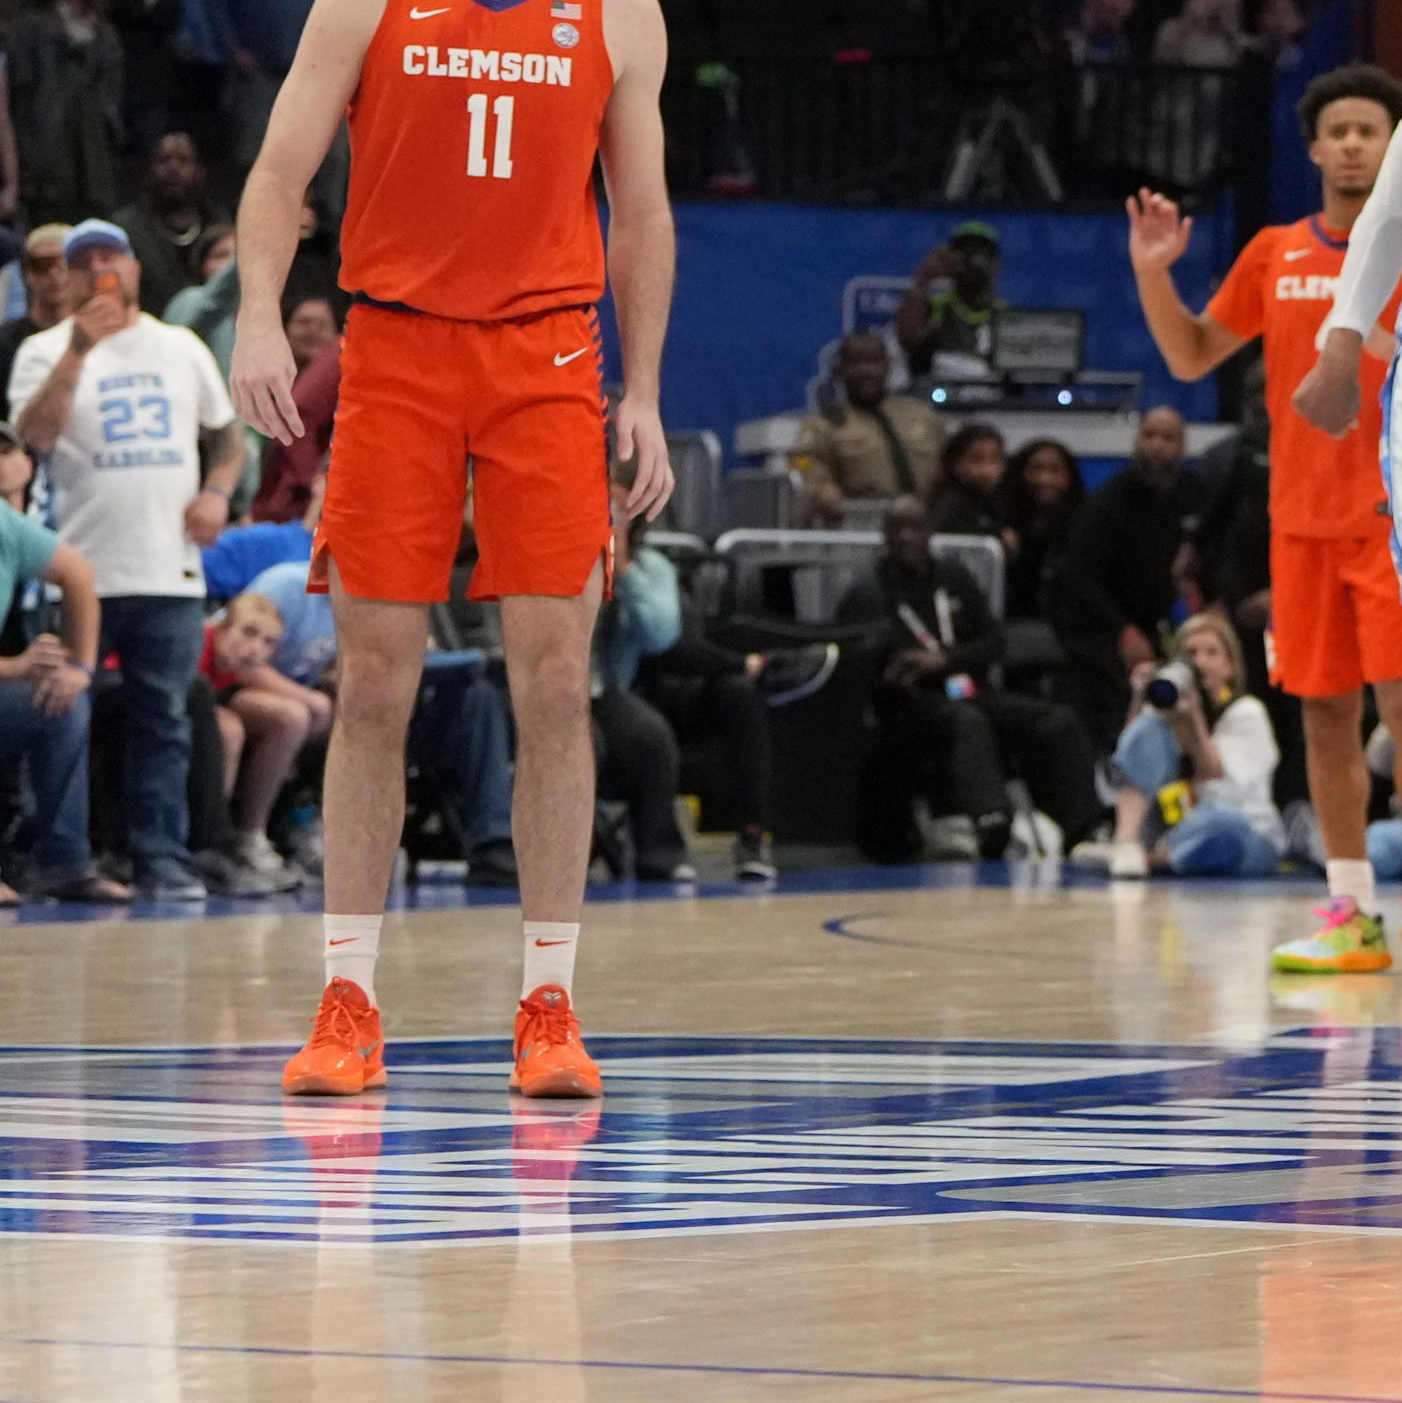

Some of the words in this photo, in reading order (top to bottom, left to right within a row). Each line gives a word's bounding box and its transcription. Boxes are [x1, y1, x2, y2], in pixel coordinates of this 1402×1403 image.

[403, 44, 573, 87] CLEMSON
[466, 93, 515, 179] 11
[1276, 275, 1341, 301] CLEM
[99, 397, 171, 443] 23
